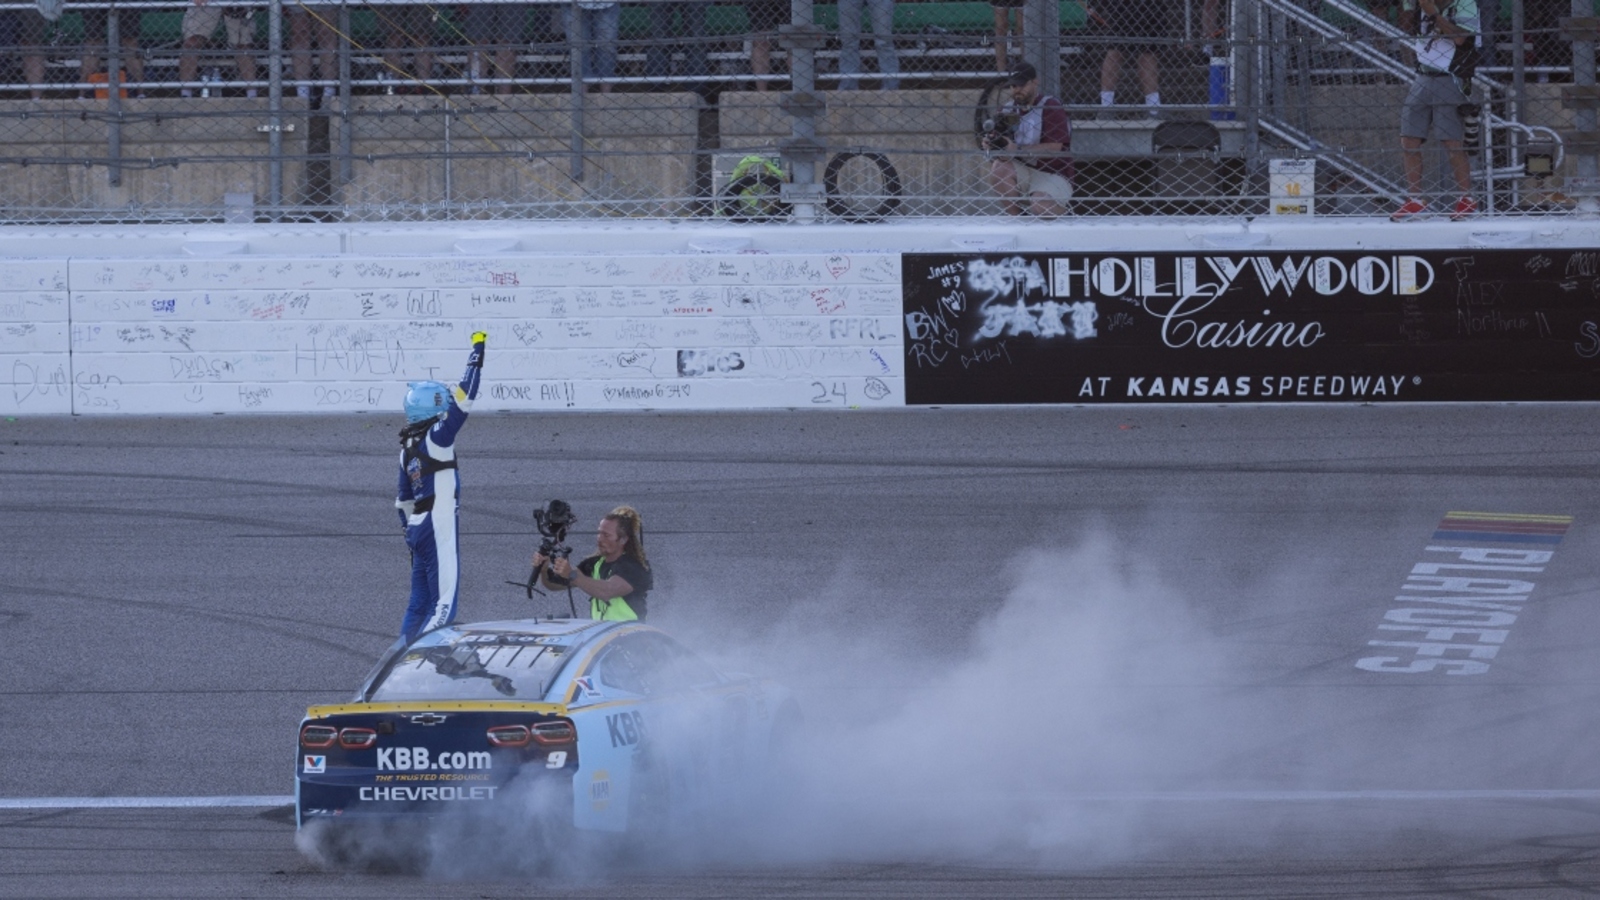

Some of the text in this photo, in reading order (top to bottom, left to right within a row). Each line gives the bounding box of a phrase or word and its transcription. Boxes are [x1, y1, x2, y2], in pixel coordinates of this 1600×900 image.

[927, 261, 965, 279] JAMES
[1048, 255, 1435, 298] HOLLYWOOD
[1143, 282, 1326, 348] Casino
[811, 381, 848, 405] 24
[1078, 377, 1111, 397] AT
[1127, 377, 1250, 397] KANSAS
[1355, 546, 1554, 675] PLAYOFFS
[376, 747, 492, 771] KBB.com
[545, 751, 567, 769] 9
[375, 774, 393, 782] THE
[395, 774, 437, 782] TRUSTED
[358, 786, 499, 801] CHEVROLET
